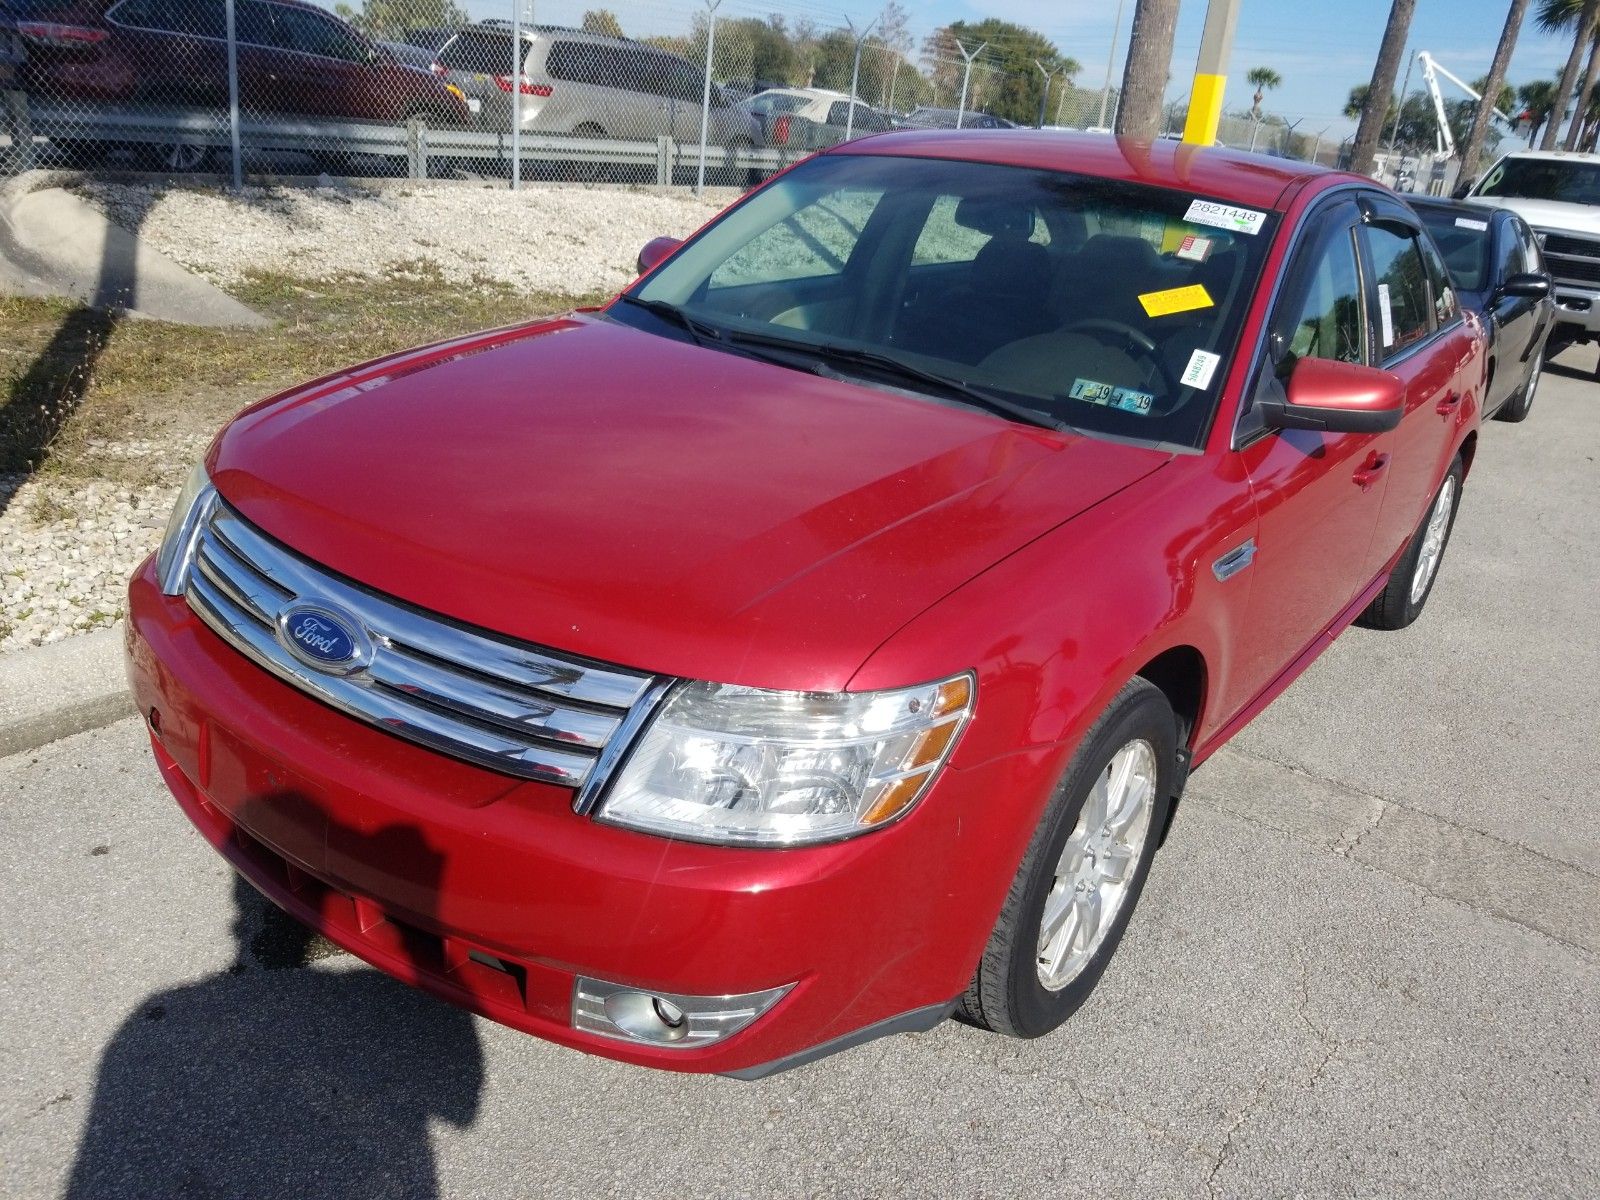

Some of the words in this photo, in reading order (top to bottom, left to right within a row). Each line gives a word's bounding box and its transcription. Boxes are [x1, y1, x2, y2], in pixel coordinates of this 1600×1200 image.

[1191, 202, 1258, 222] 2821448
[1095, 385, 1110, 400] 19
[1136, 395, 1151, 410] 19
[294, 617, 340, 654] Ford
